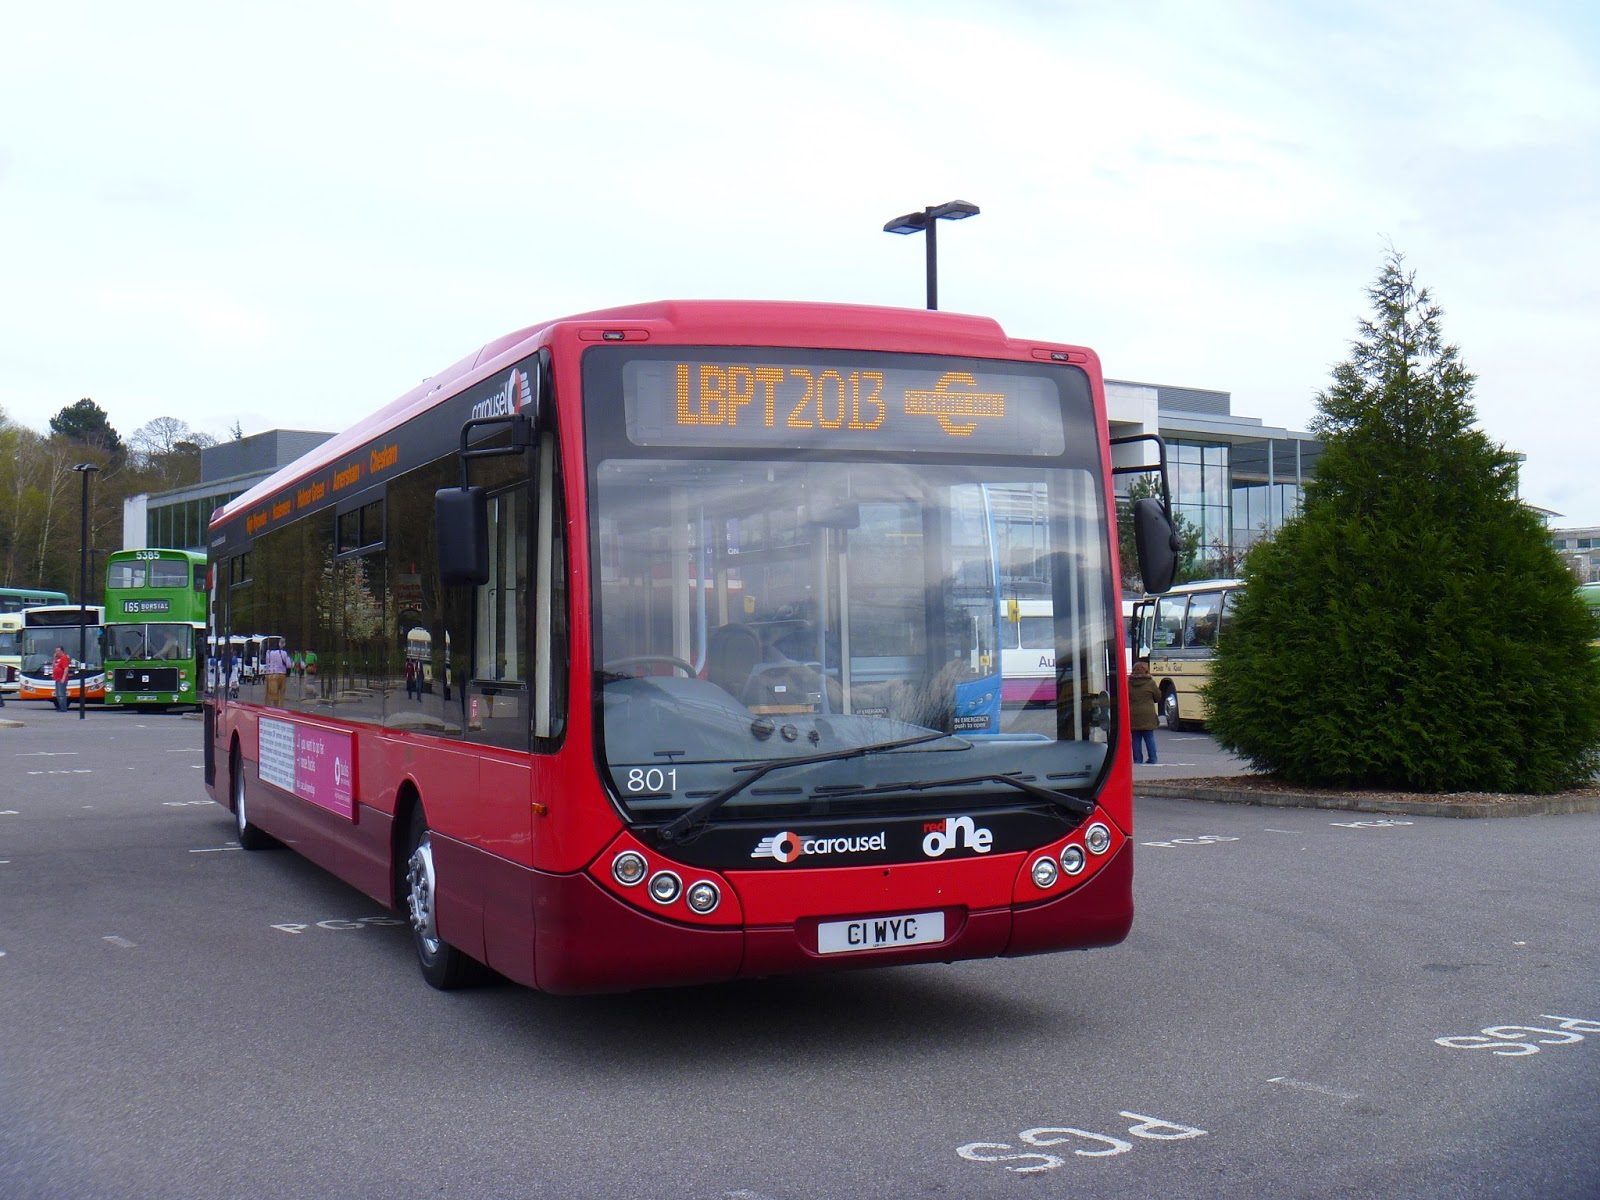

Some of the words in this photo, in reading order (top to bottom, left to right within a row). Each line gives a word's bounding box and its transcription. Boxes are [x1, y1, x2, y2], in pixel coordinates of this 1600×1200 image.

[472, 381, 508, 420] carousel
[369, 443, 399, 475] Chesham
[136, 551, 160, 560] 5385
[124, 602, 139, 613] 165
[960, 716, 989, 724] EMERGENCY
[627, 768, 676, 792] 801
[923, 818, 946, 834] red
[803, 831, 887, 855] carousel
[875, 917, 917, 943] WYC
[955, 1110, 1209, 1173] PGS
